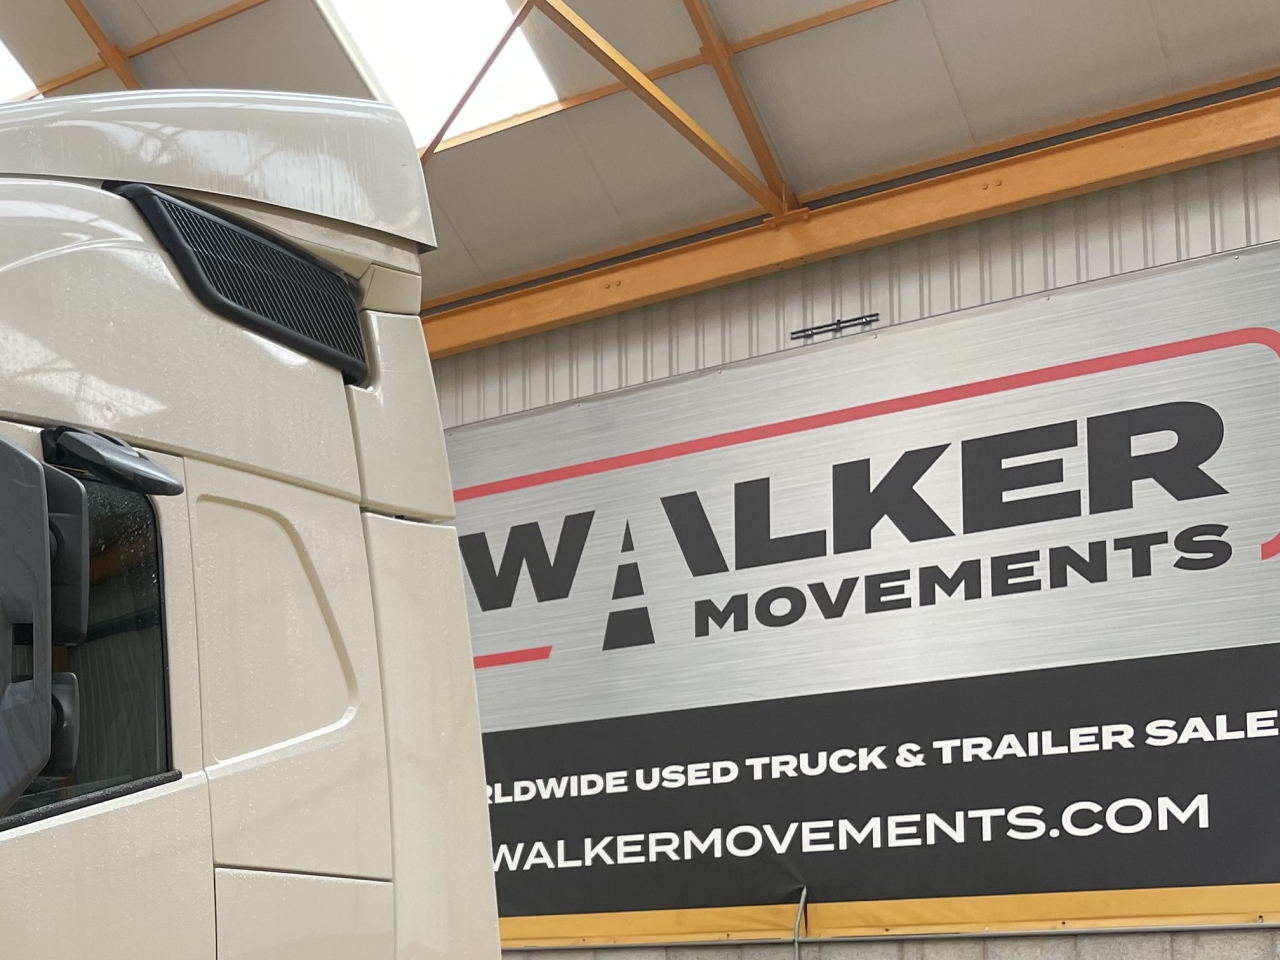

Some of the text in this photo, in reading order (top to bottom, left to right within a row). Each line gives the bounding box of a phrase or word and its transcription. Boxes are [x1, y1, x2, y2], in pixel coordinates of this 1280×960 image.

[458, 401, 1229, 651] WALKER
[694, 523, 1232, 639] MOVEMENTS
[636, 760, 739, 791] USED
[745, 744, 887, 781] TRUCK
[895, 743, 926, 768] &
[933, 723, 1135, 764] TRAILER
[1145, 709, 1279, 747] SALE
[494, 793, 1209, 872] WALKERMOVEMENTS.COM
